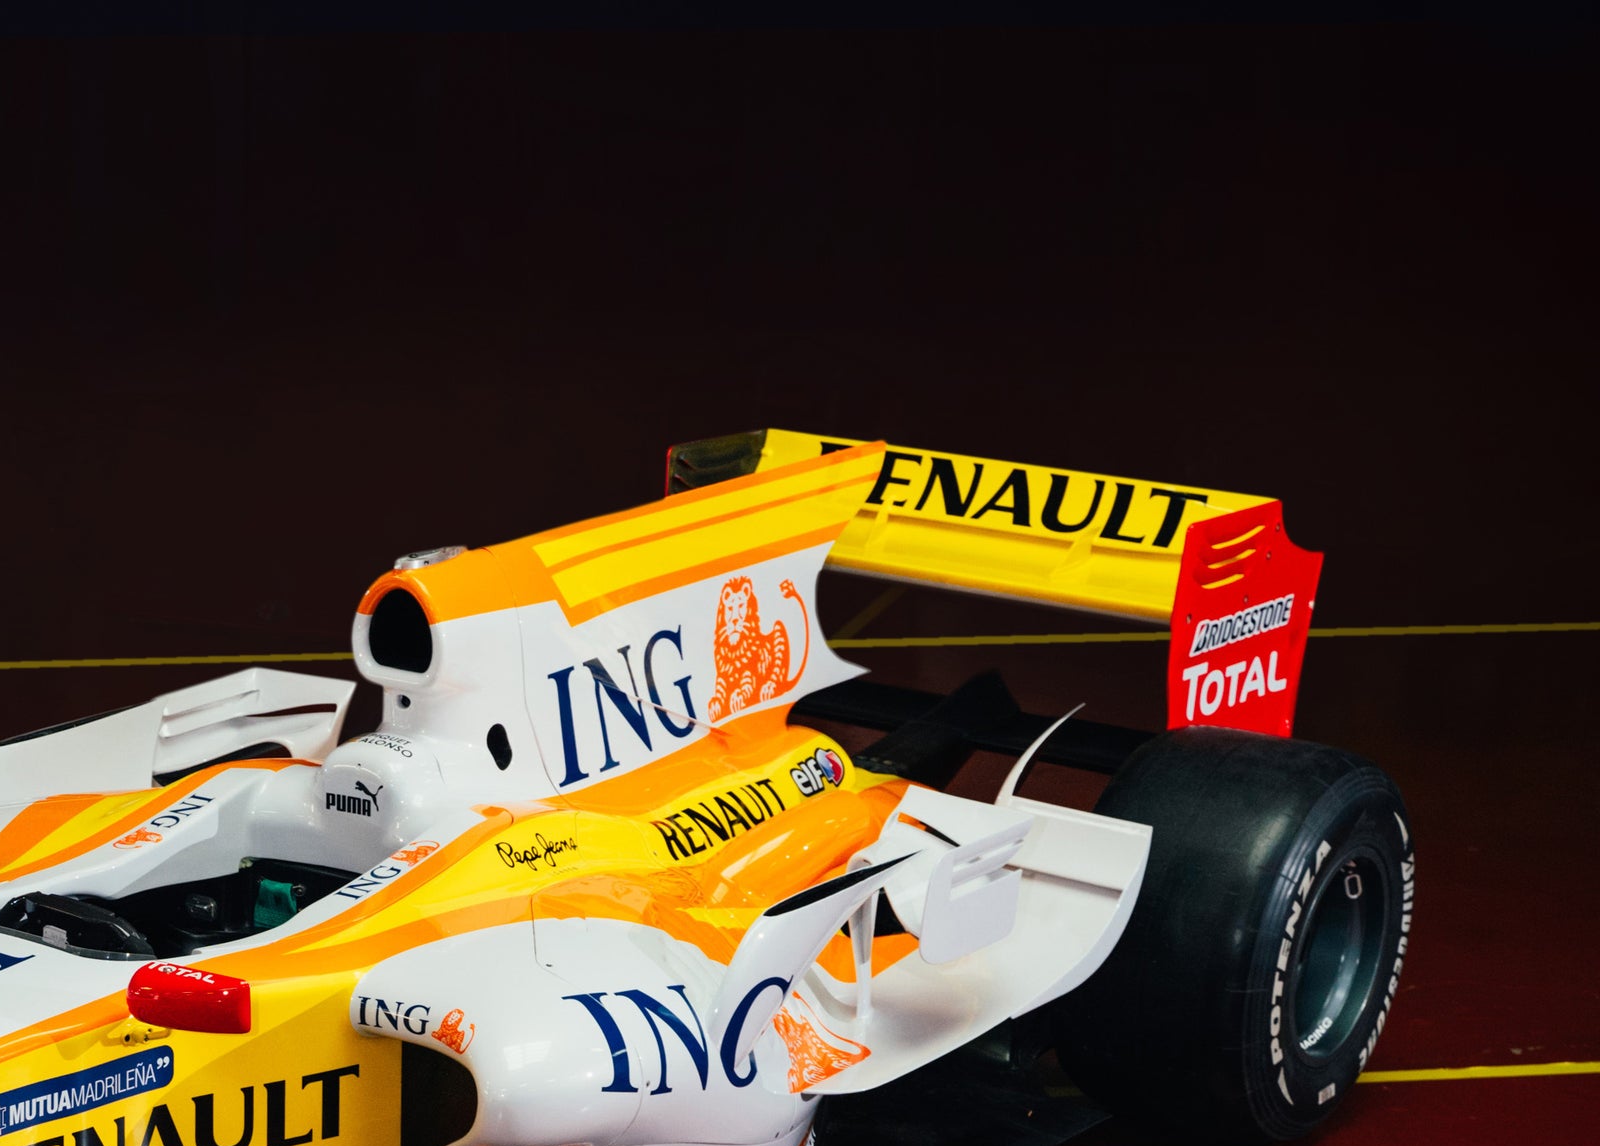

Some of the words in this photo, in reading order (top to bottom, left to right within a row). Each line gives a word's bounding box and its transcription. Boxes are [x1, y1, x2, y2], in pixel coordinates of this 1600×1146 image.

[820, 441, 1208, 549] ENAULT
[1192, 596, 1294, 656] BRIDGESTONE
[548, 624, 698, 787] ING
[1182, 651, 1287, 721] TOTAL
[359, 737, 413, 758] ALONSO
[791, 758, 824, 795] elf
[151, 794, 215, 828] ING
[326, 793, 371, 817] PUMA
[658, 778, 787, 861] RENAULT
[495, 842, 541, 871] Pepe
[535, 833, 578, 867] Jeans
[334, 865, 401, 900] ING
[148, 961, 215, 984] TOTAL
[1270, 840, 1332, 1066] POTENZA
[357, 996, 430, 1036] ING
[562, 975, 793, 1096] ING
